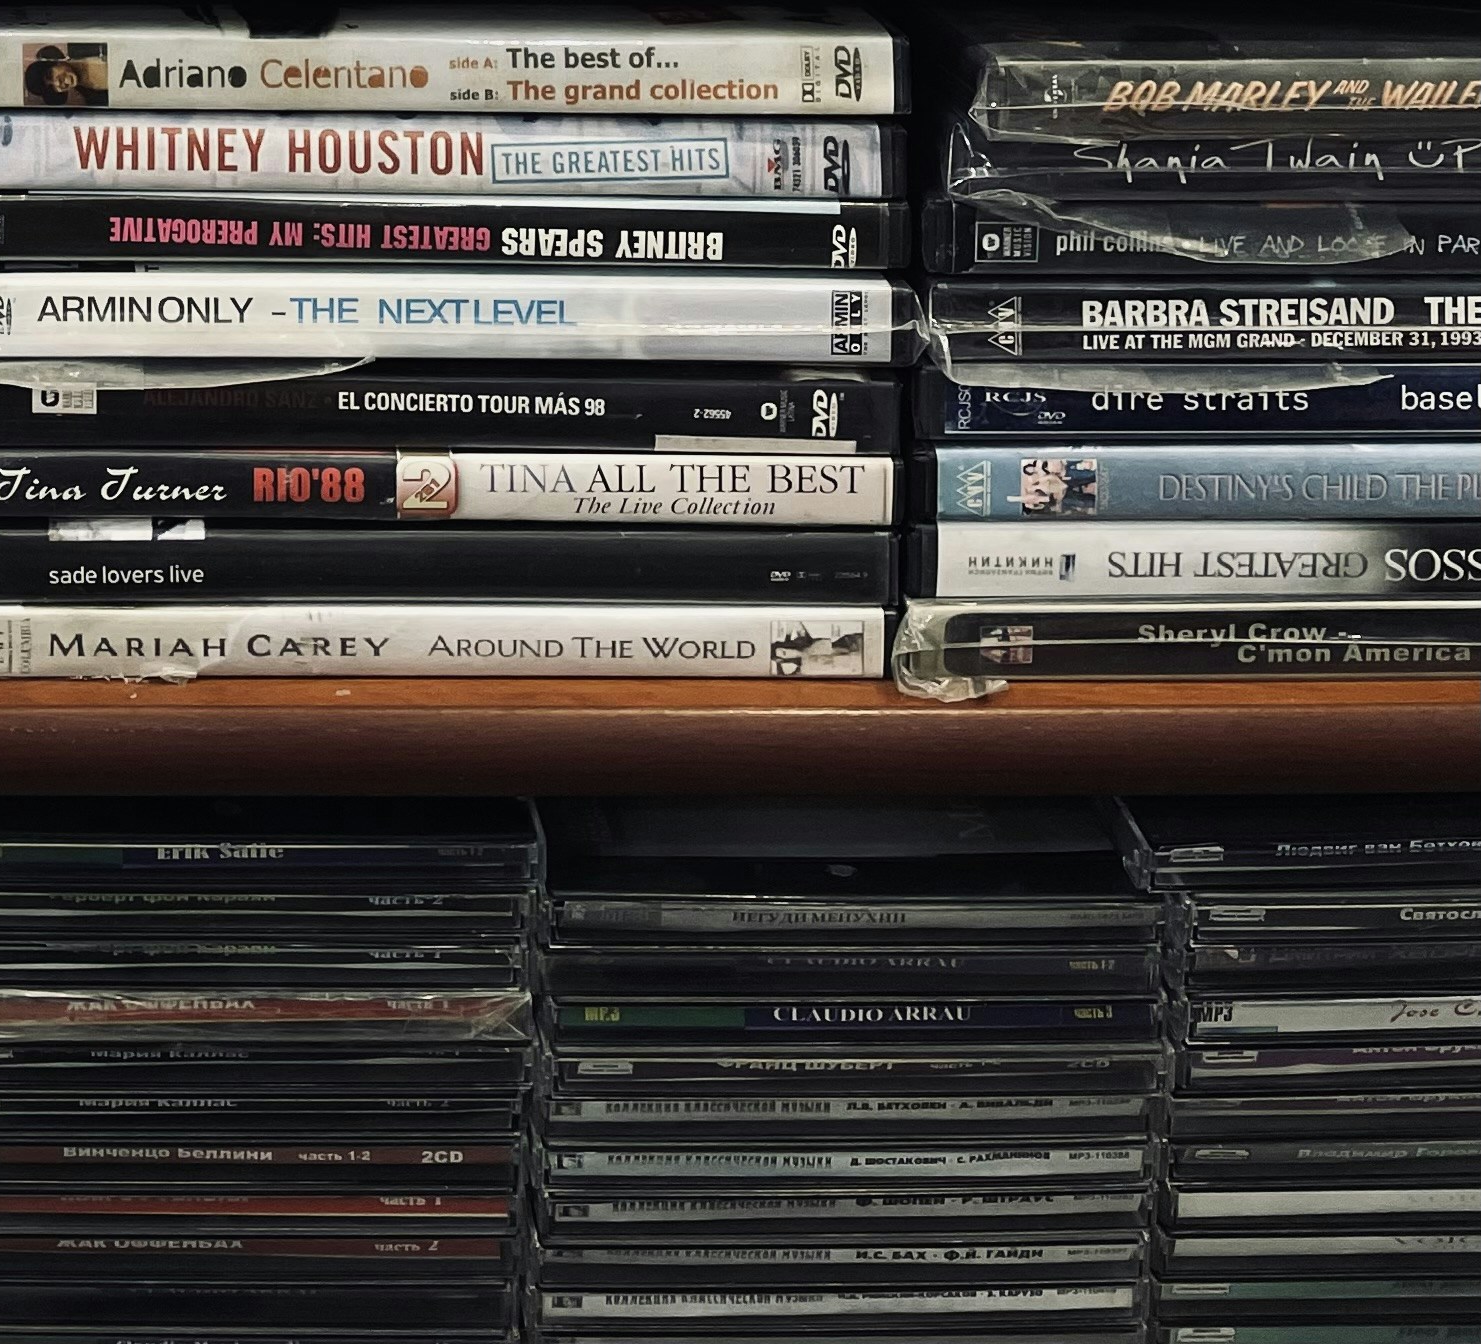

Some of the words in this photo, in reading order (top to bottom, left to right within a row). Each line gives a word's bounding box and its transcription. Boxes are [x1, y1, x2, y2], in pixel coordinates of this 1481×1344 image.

[449, 56, 480, 70] side
[484, 57, 498, 70] A:
[506, 47, 557, 69] The
[564, 47, 622, 70] best
[628, 47, 680, 71] of...
[119, 59, 247, 88] Adriano
[260, 60, 429, 90] Celentano
[449, 87, 482, 102] side
[485, 89, 499, 102] B:
[507, 80, 559, 101] The
[564, 81, 641, 106] grand
[650, 80, 778, 101] collection
[502, 229, 603, 257] SPEARS
[616, 231, 723, 260] BRITNEY
[1082, 300, 1210, 328] BARBRA
[1219, 297, 1394, 326] STREISAND
[100, 468, 227, 502] Turner
[253, 467, 364, 503] RIO'88
[49, 567, 97, 585] sade
[101, 566, 164, 585] lovers
[168, 565, 203, 584] live
[773, 1006, 882, 1023] CLAUDIO
[888, 1004, 972, 1022] ARRAU
[298, 1150, 339, 1161] часть
[346, 1150, 371, 1160] 1-2
[421, 1150, 463, 1164] 2CD
